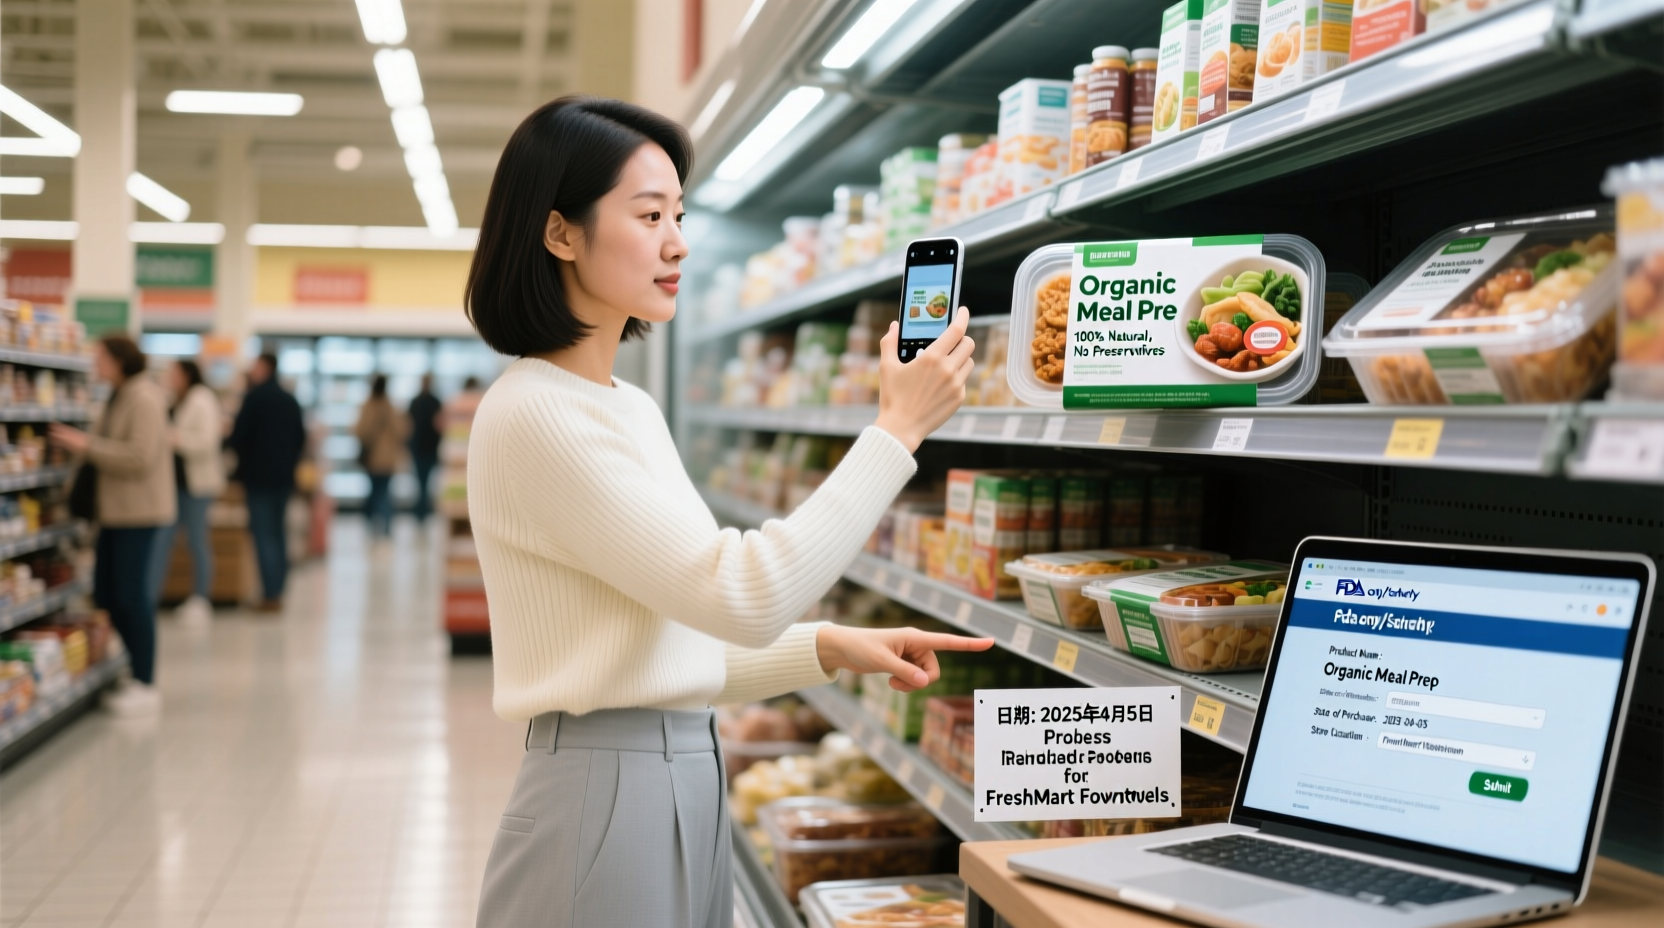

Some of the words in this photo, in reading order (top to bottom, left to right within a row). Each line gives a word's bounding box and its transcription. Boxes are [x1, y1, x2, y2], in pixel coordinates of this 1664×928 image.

[1079, 271, 1176, 300] Organic
[1076, 300, 1132, 322] Meal
[1138, 300, 1178, 321] Pre
[1074, 331, 1105, 342] 100%
[1108, 330, 1153, 343] Natural,
[1074, 345, 1089, 357] No
[1335, 578, 1366, 597] FDA
[1323, 661, 1373, 682] Organic
[1374, 667, 1408, 685] Meal
[1408, 670, 1440, 691] Prep
[1040, 703, 1153, 725] 2025年4月5日
[1044, 728, 1112, 745] Probess
[1064, 767, 1088, 784] for
[986, 788, 1075, 806] FreshMart
